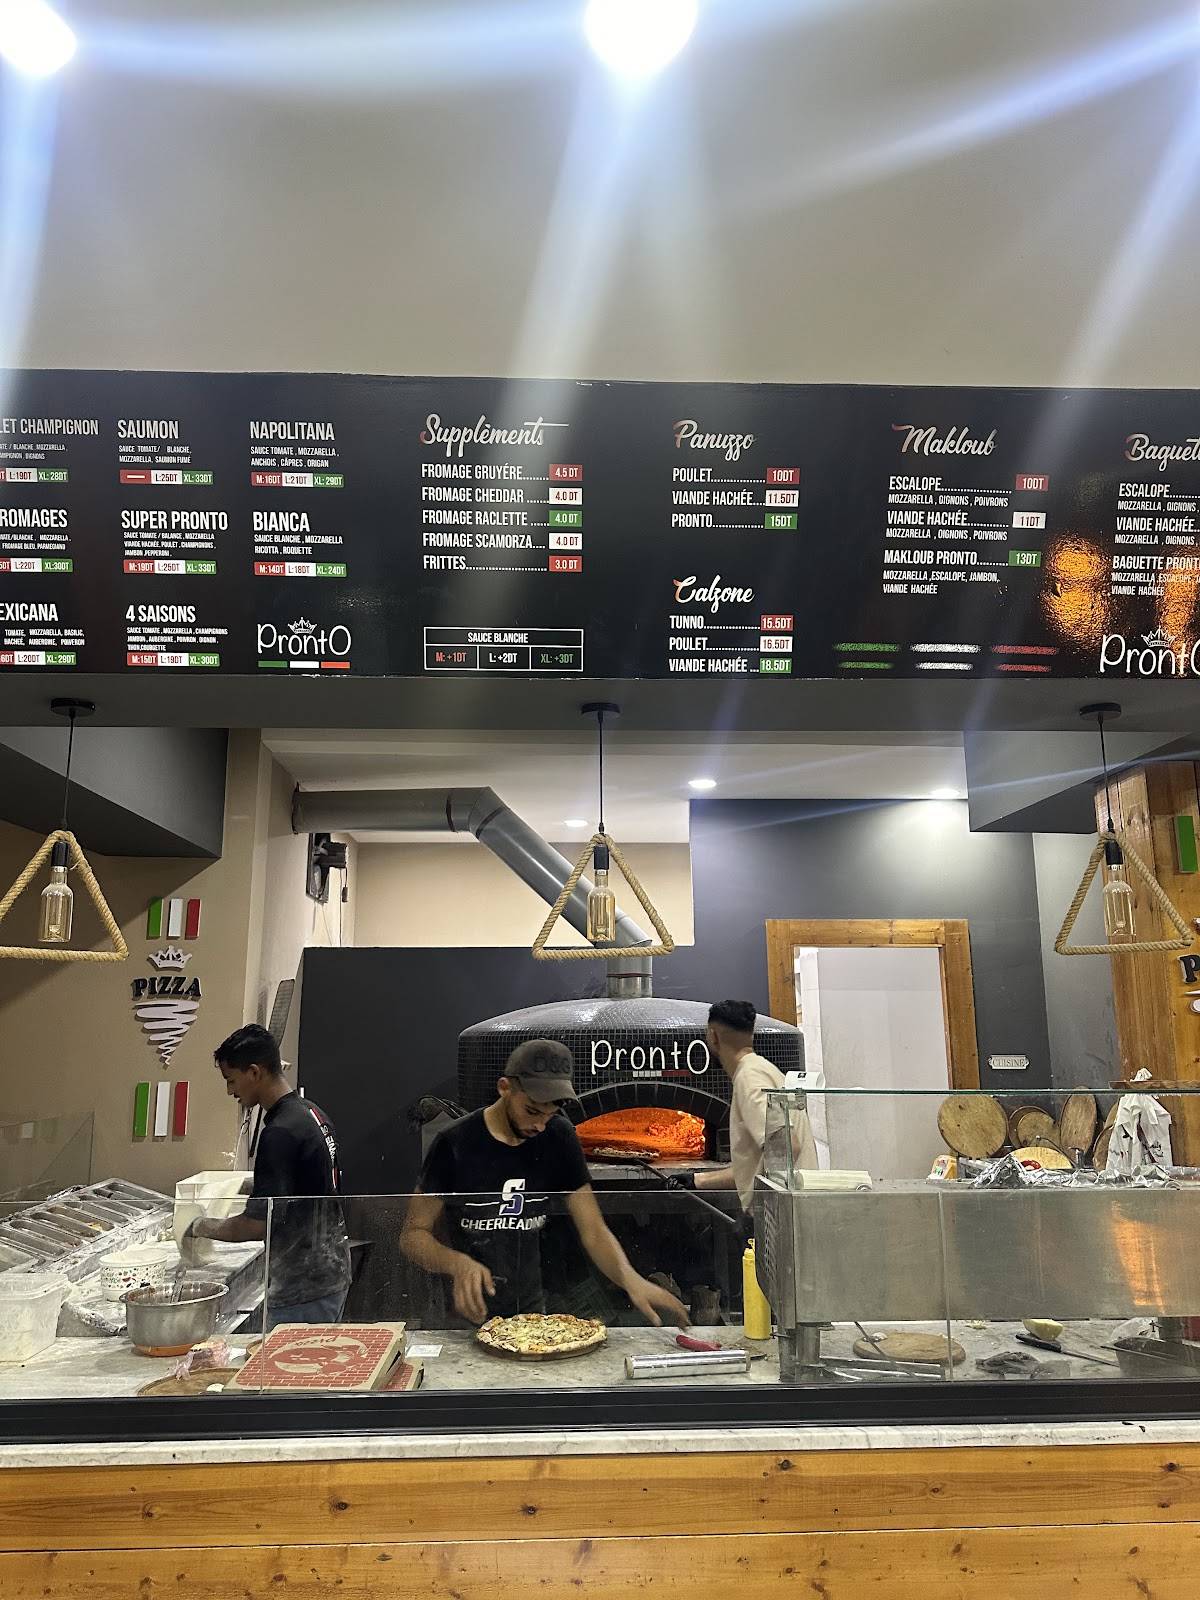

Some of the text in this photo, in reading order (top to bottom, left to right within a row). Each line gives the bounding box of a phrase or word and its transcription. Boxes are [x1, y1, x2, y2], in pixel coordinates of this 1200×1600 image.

[20, 418, 99, 435] CHAMPIGNON
[117, 419, 179, 439] SAUMON
[249, 421, 335, 440] NAPOLITANA
[673, 419, 758, 461] Panuzzo
[891, 423, 999, 456] Makloub
[421, 463, 472, 479] FROMAGE
[773, 470, 794, 482] 10DT
[1022, 477, 1044, 490] 10DT
[421, 486, 472, 502] FROMAGE
[475, 488, 524, 503] CHEDDAR
[672, 490, 710, 506] VIANDE
[768, 493, 797, 504] 11.5DT
[973, 496, 1009, 508] POIVRONS
[0, 508, 68, 528] ROMAGES
[121, 510, 229, 531] SUPER PRONTO
[253, 511, 310, 532] BIANCA
[422, 509, 472, 525] FROMAGE
[475, 511, 528, 526] RACLETTE
[770, 515, 792, 527] 15DT
[887, 511, 924, 526] VIANDE
[1020, 516, 1040, 527] 11DT
[1116, 516, 1153, 531] VIANDE
[422, 532, 473, 548] FROMAGE
[973, 530, 1008, 541] POIVRONS
[884, 550, 934, 565] MAKLOUB
[1015, 553, 1038, 565] 13DT
[1113, 555, 1164, 570] BAGUETTE
[672, 574, 755, 613] Calzone
[883, 582, 938, 594] VIANDE HACHÉE
[1111, 585, 1136, 596] VIANDE
[0, 602, 59, 621] EXICANA
[125, 604, 197, 623] 4 SAISONS
[467, 632, 529, 644] SAUCE BLANCHE
[669, 658, 706, 673] VIANDE
[707, 656, 748, 673] HACHÉE
[132, 976, 202, 998] PIZZA
[992, 1056, 1025, 1066] CUISINE
